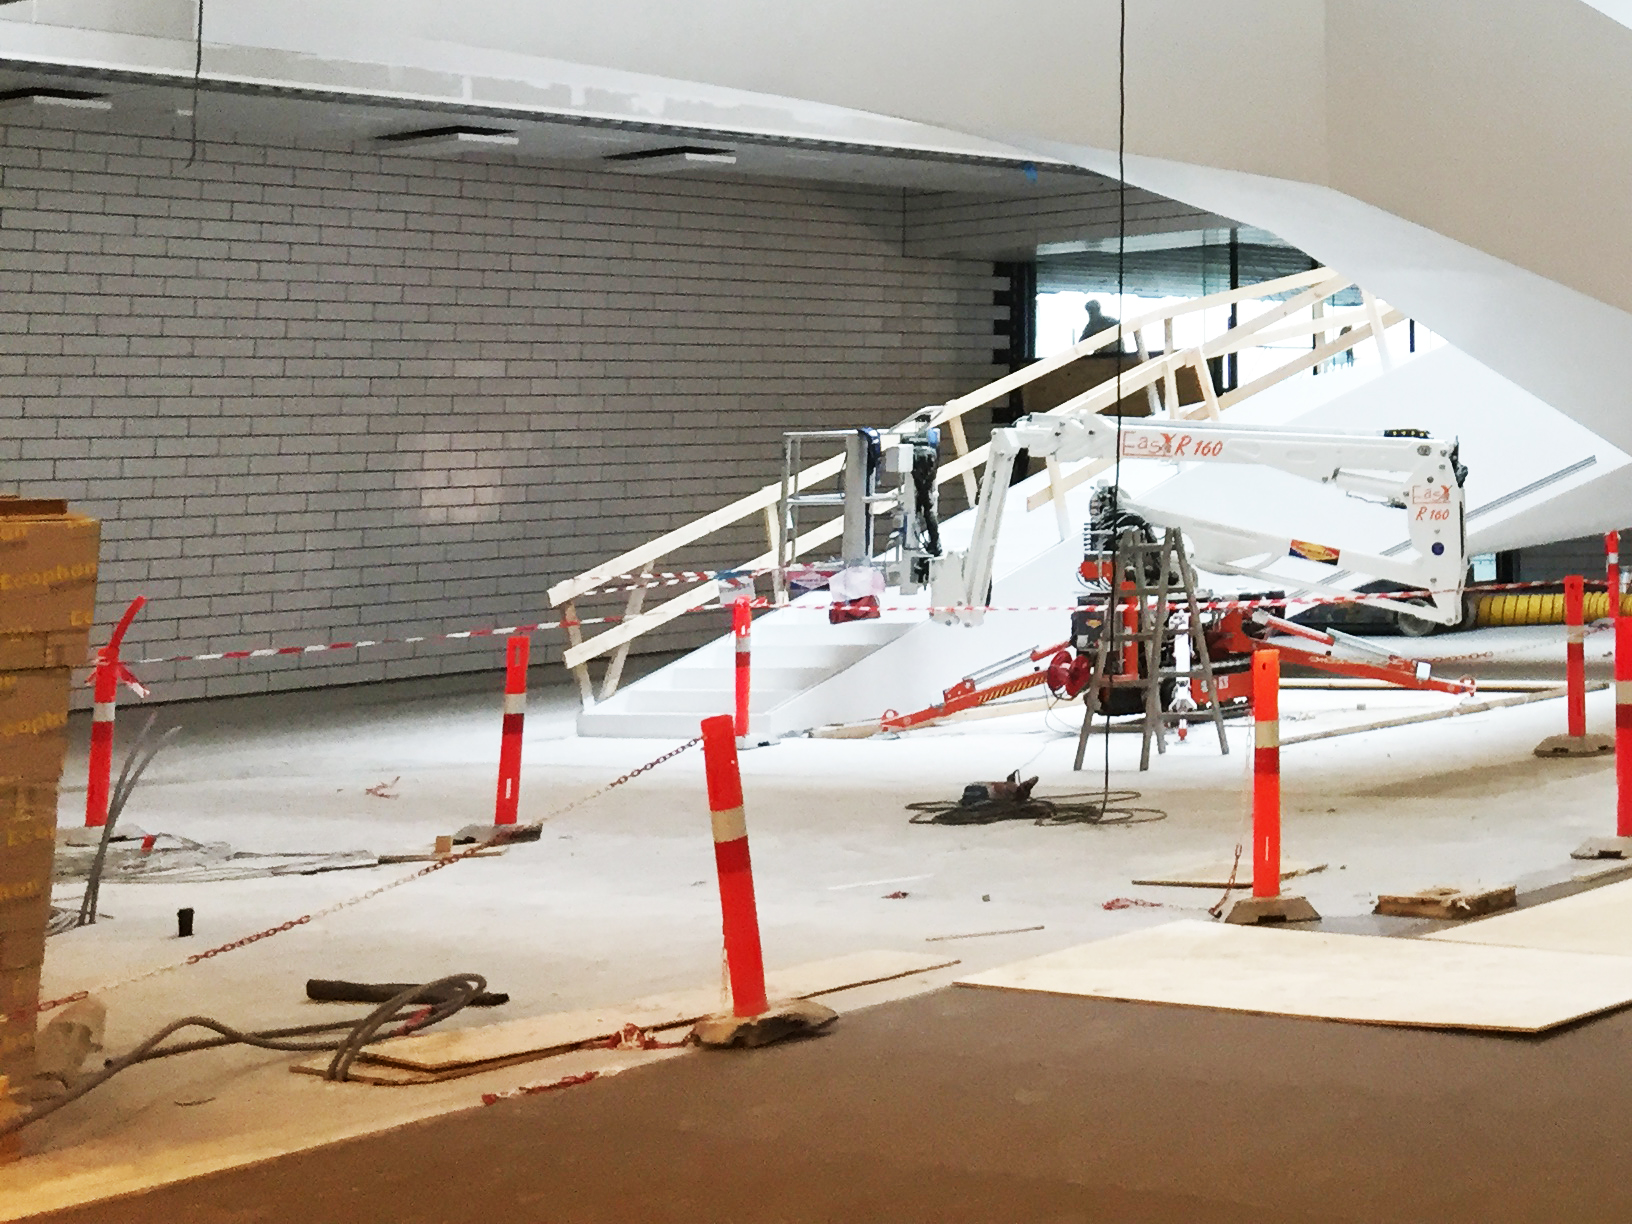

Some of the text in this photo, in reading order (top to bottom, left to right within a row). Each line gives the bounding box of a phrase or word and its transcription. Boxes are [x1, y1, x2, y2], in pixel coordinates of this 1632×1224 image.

[1174, 434, 1192, 456] R
[1193, 440, 1223, 456] 160
[1415, 506, 1449, 521] R 160
